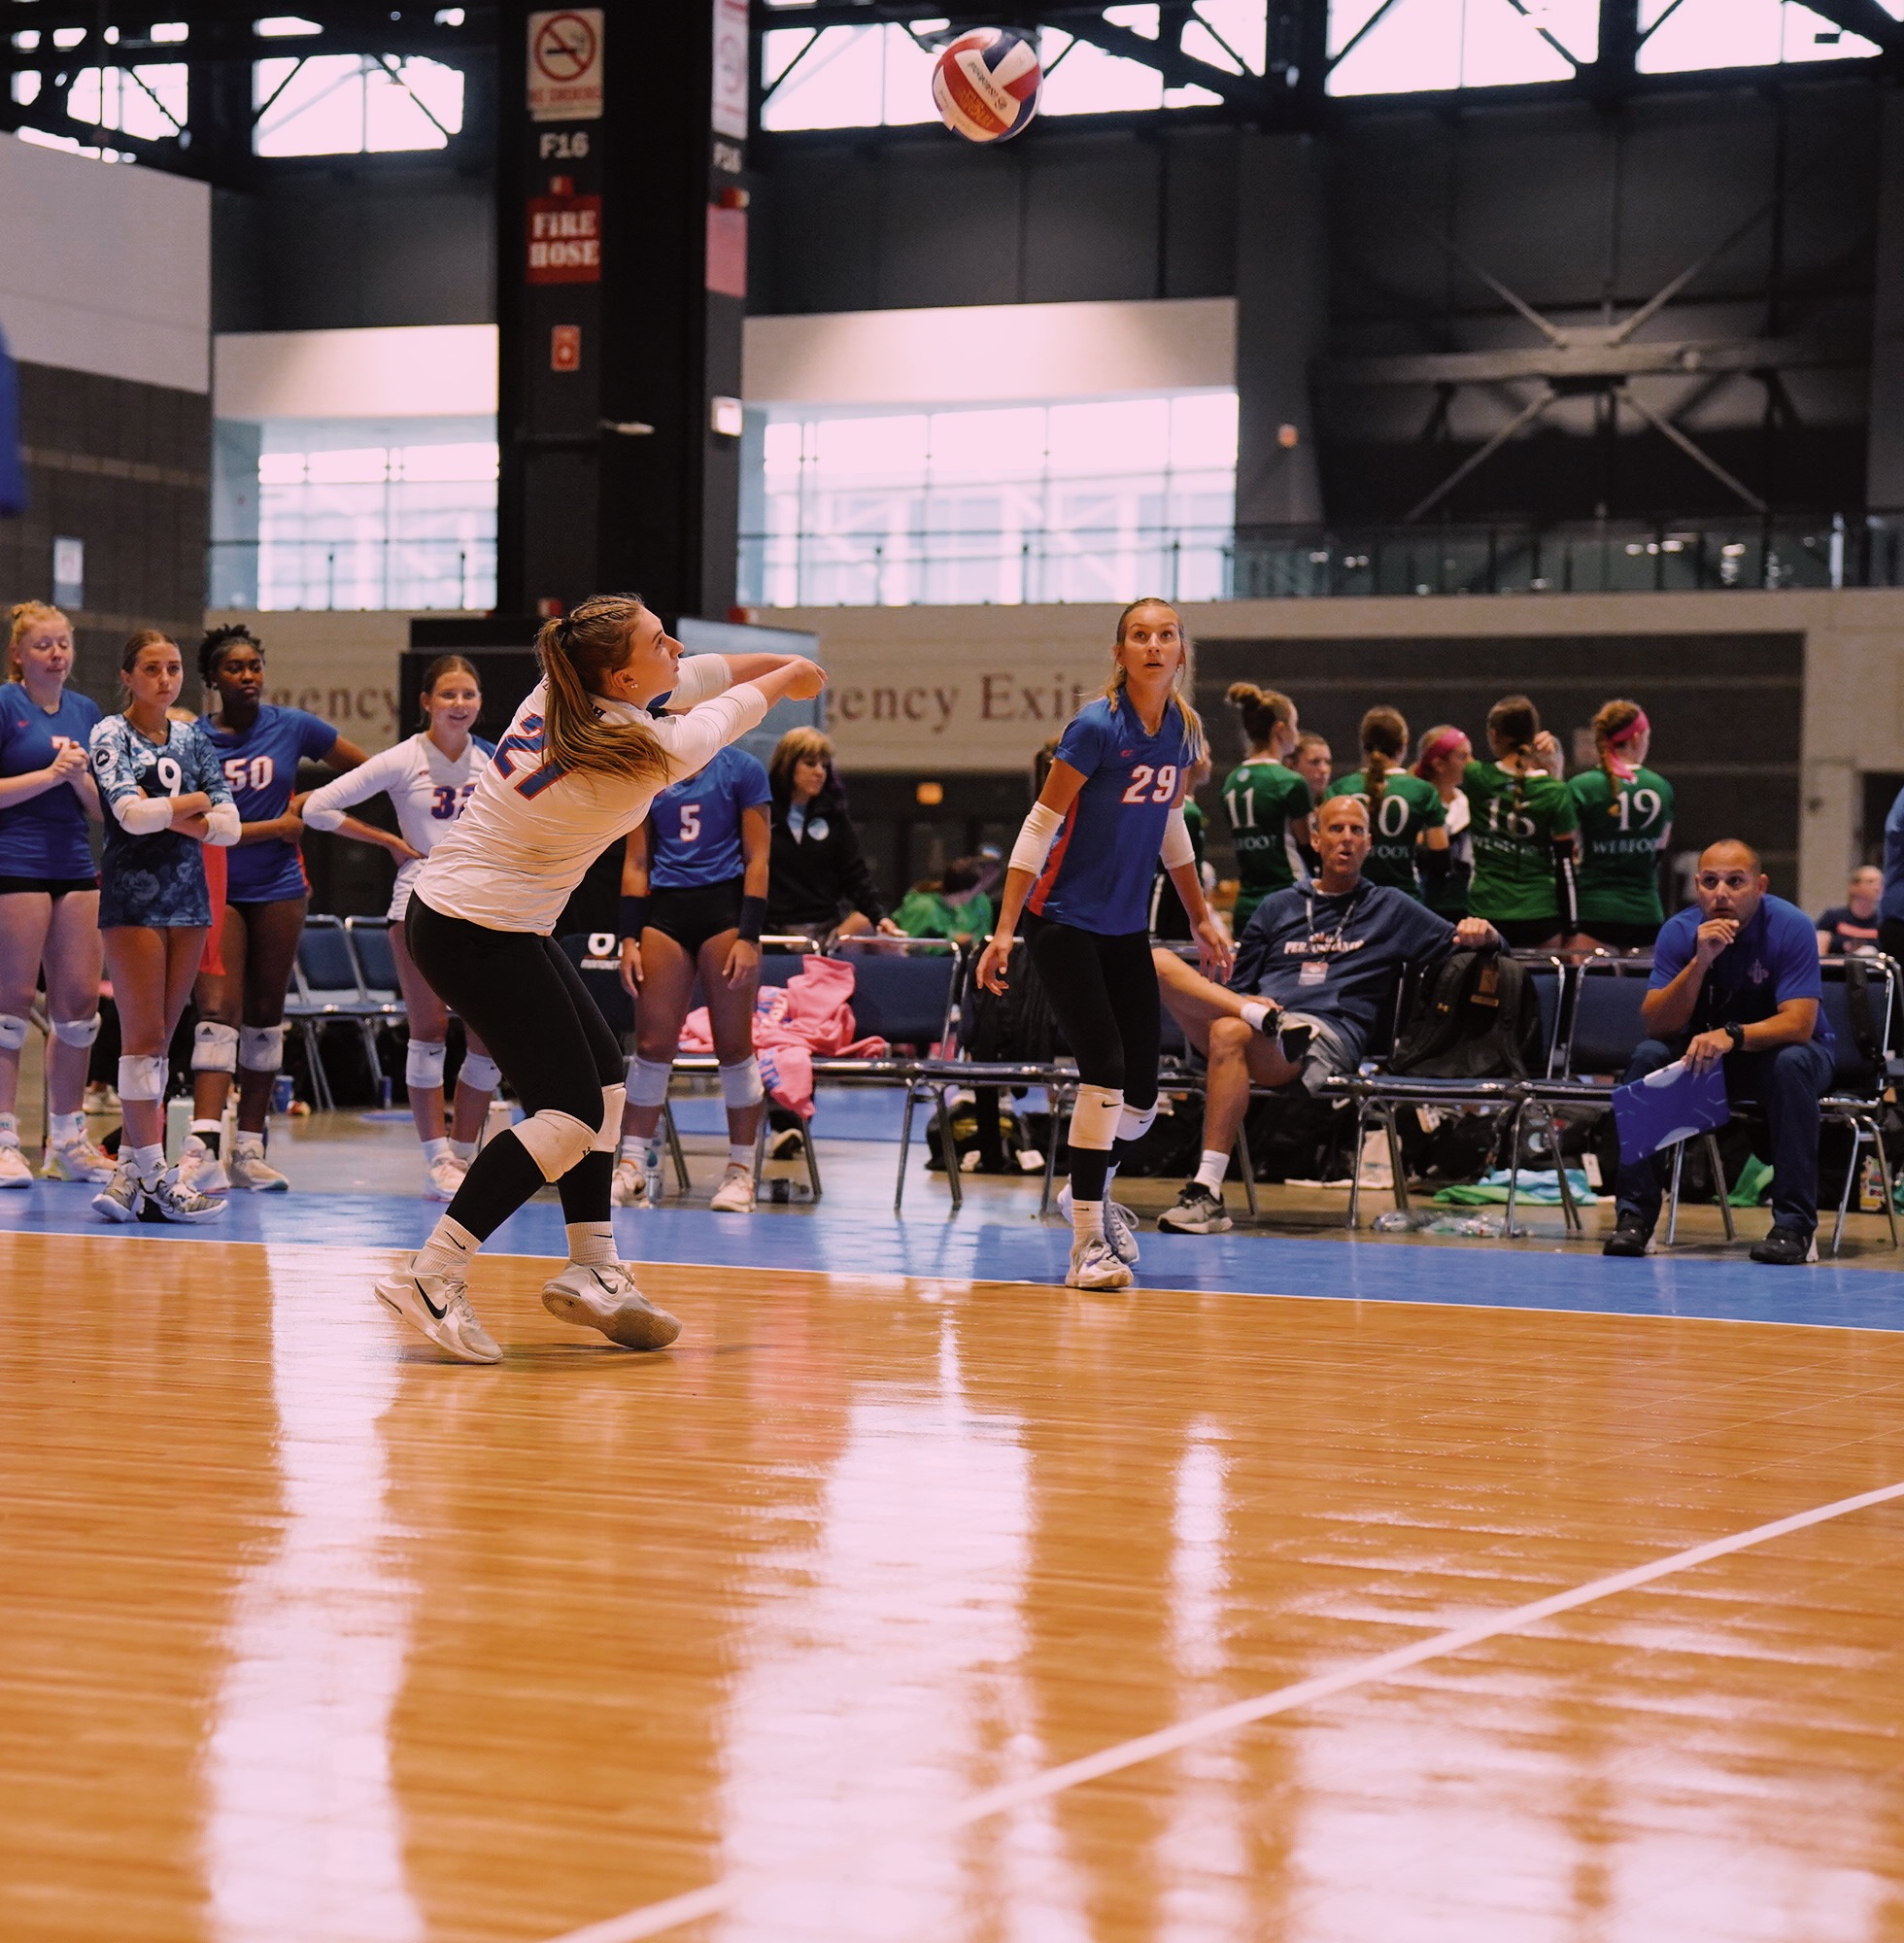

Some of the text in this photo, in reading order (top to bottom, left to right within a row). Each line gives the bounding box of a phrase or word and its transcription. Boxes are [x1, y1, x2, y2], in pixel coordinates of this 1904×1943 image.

[539, 133, 590, 159] F16
[533, 210, 596, 239] FIRE
[529, 240, 600, 268] HOSE
[825, 685, 961, 735] ency
[157, 757, 182, 798] 9
[223, 755, 273, 793] 50
[1120, 764, 1177, 804] 29
[680, 803, 701, 842] 5
[1225, 787, 1258, 830] 11
[1617, 788, 1662, 831] 19
